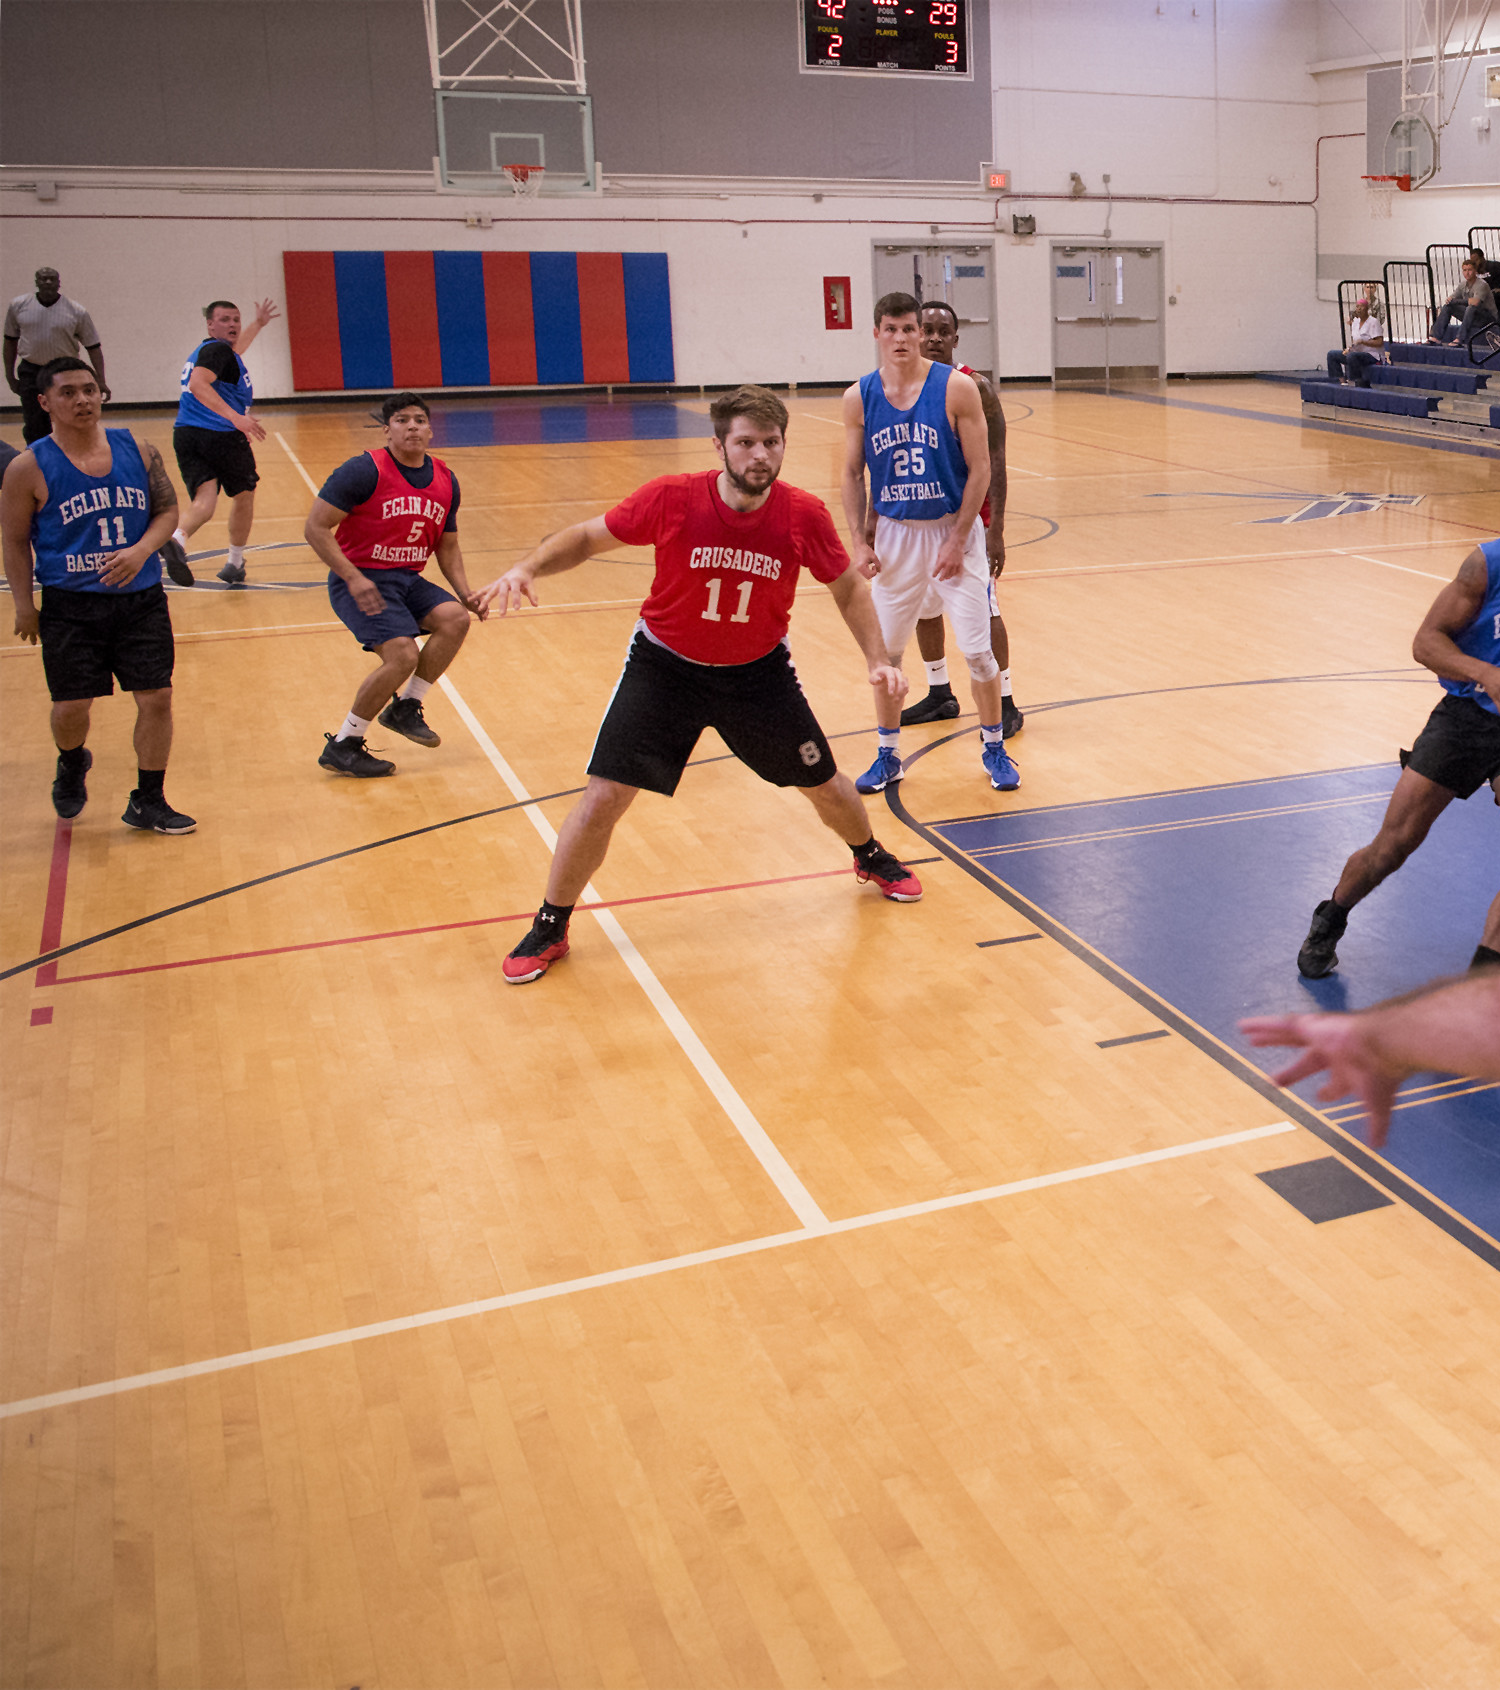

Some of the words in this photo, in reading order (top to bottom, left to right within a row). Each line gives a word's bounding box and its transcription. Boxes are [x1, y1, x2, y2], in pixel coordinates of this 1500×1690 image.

[817, 0, 846, 19] 42
[877, 16, 898, 25] BONUS
[929, 2, 957, 25] 29
[875, 29, 898, 37] PLAYER
[934, 32, 955, 40] FOULS
[828, 34, 843, 58] 2
[946, 41, 958, 63] 3
[818, 58, 841, 66] POINTS
[876, 61, 899, 69] MATCH
[934, 64, 956, 72] POINTS
[871, 422, 911, 456] EGLIN
[912, 421, 939, 449] AFB
[892, 447, 926, 477] 25
[58, 486, 112, 526] EGLIN
[115, 485, 146, 511] AFB
[381, 495, 422, 520] EGLIN
[422, 498, 446, 526] AFB
[97, 515, 128, 547] 11
[406, 520, 425, 543] 5
[370, 543, 429, 562] BASKETBAL
[689, 546, 782, 581] CRUSADERS
[700, 577, 754, 624] 11
